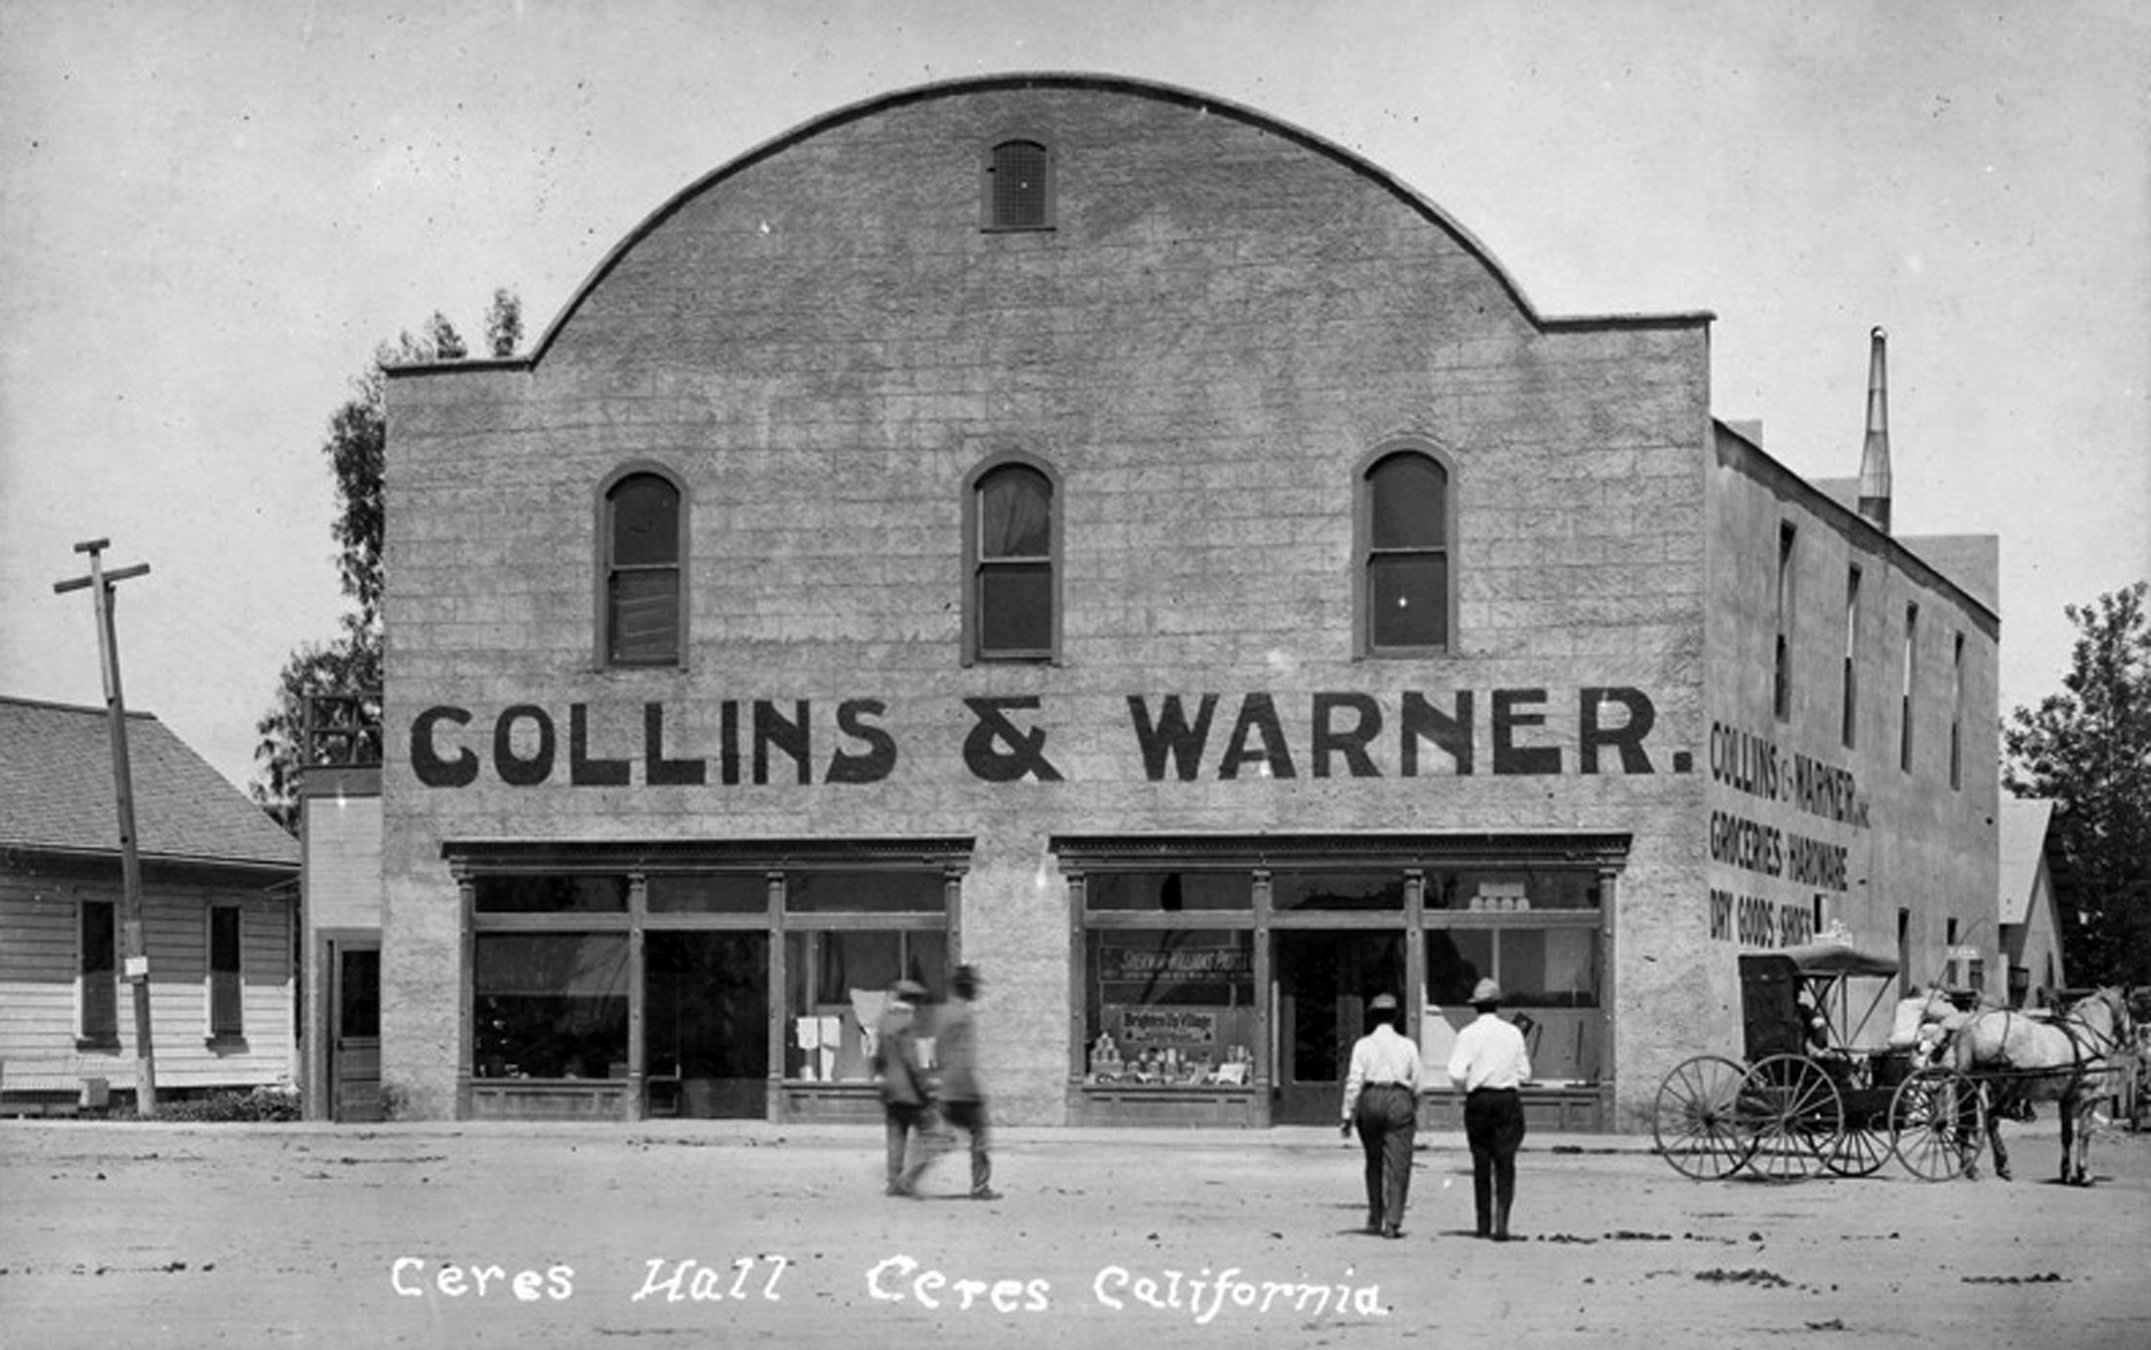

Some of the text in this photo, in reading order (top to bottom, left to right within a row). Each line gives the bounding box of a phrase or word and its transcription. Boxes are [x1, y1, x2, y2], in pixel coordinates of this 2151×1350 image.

[410, 687, 1693, 788] COLLINS & WARNER.
[1711, 721, 1777, 800] COLLINS
[1711, 889, 1733, 941] DRY
[1738, 896, 1774, 948] GOODS
